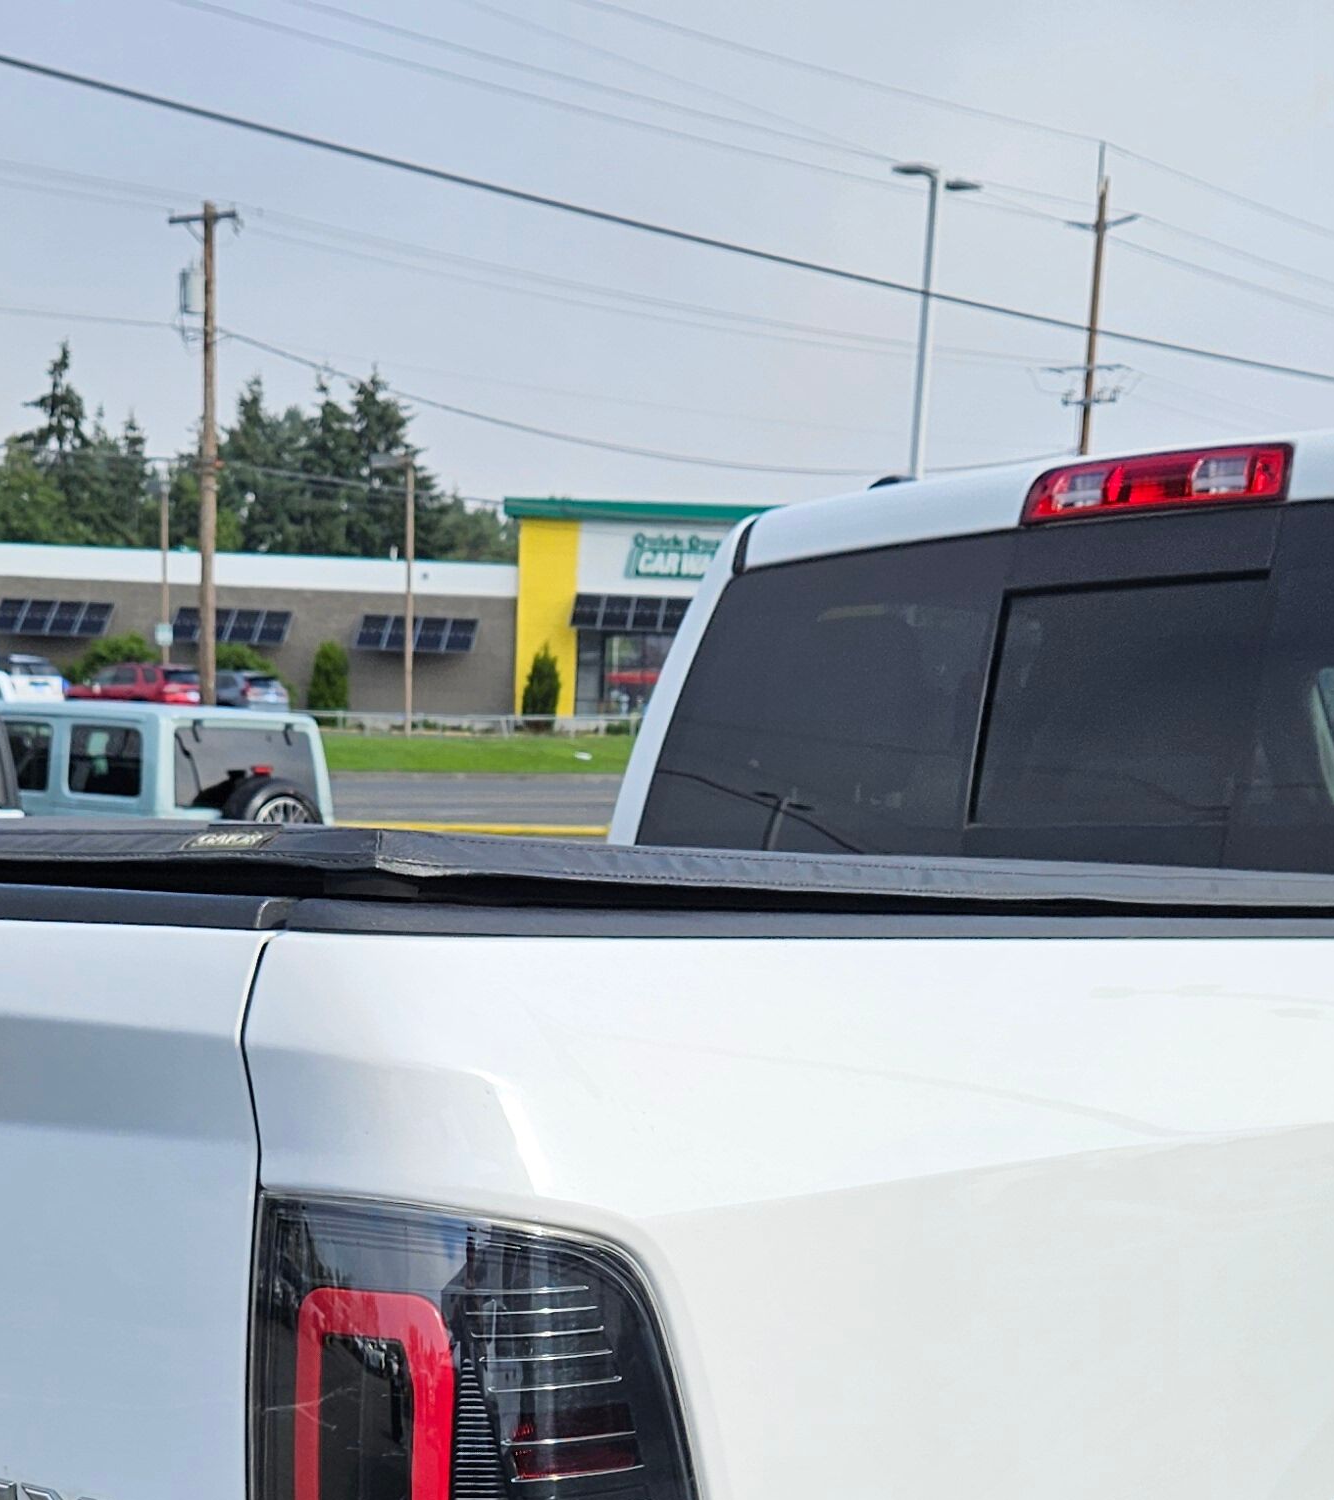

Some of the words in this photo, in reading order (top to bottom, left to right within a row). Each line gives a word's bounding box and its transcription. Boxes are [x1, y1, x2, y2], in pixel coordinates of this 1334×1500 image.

[688, 534, 722, 552] Qua
[638, 550, 680, 576] CAR
[681, 551, 716, 577] WA
